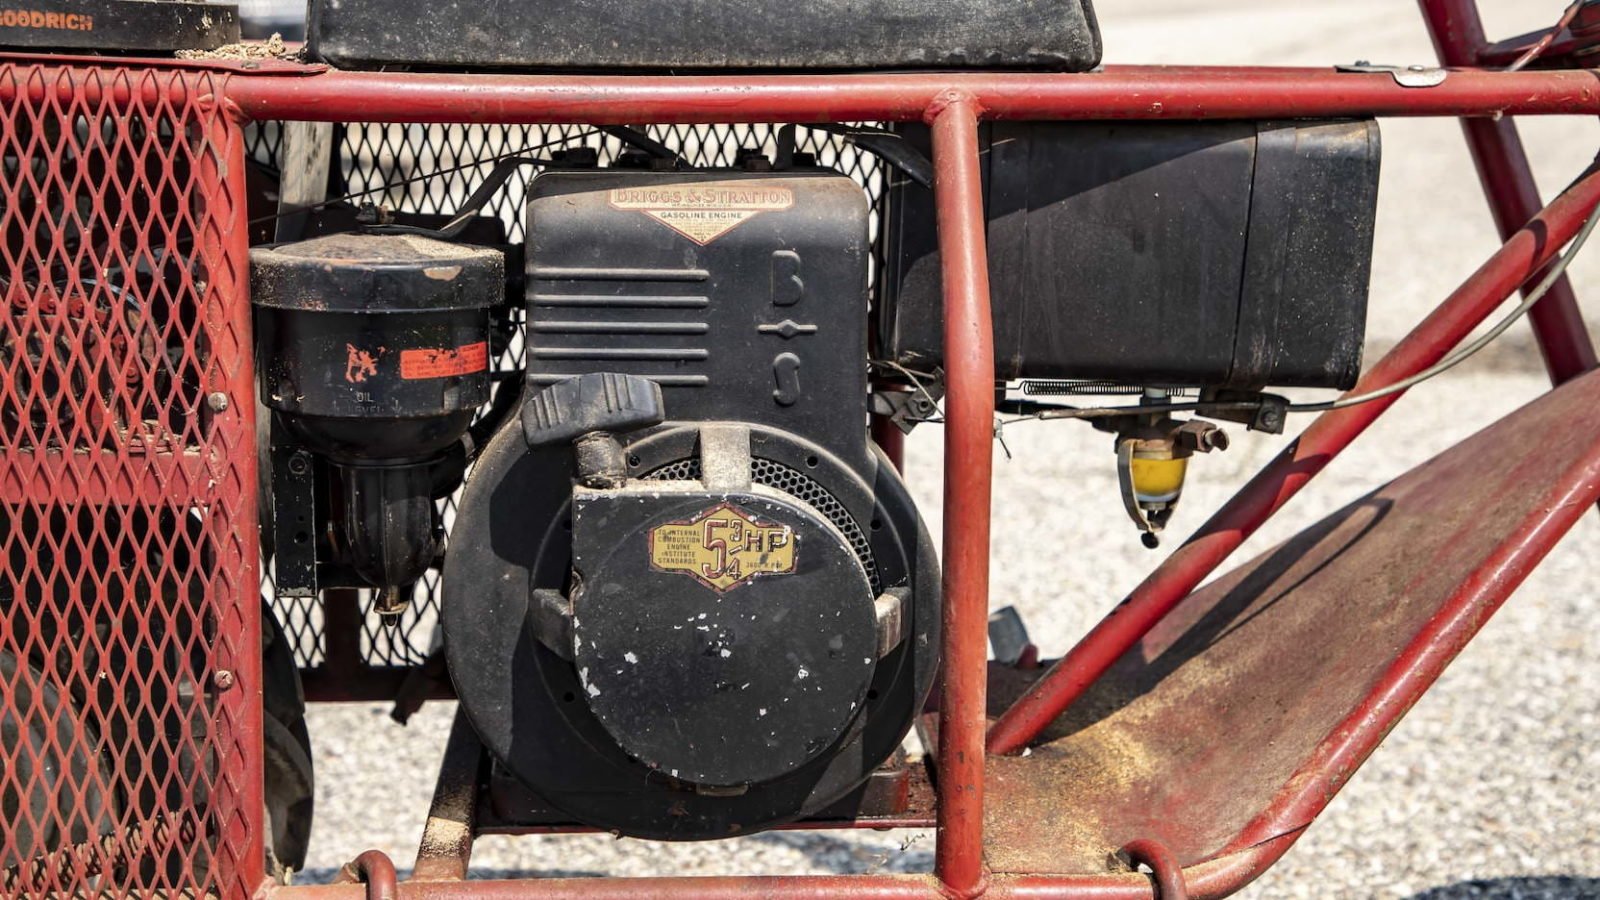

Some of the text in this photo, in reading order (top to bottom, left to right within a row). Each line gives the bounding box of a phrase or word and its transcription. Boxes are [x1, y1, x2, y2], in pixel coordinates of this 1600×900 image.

[0, 9, 94, 31] OODRICH
[686, 188, 701, 203] &
[701, 188, 791, 205] STRATTON
[660, 211, 742, 219] GASOLINE ENGINE
[355, 392, 374, 403] OIL
[657, 536, 701, 544] COMBUSTION
[744, 530, 789, 553] HP
[658, 557, 697, 565] STANDARDS
